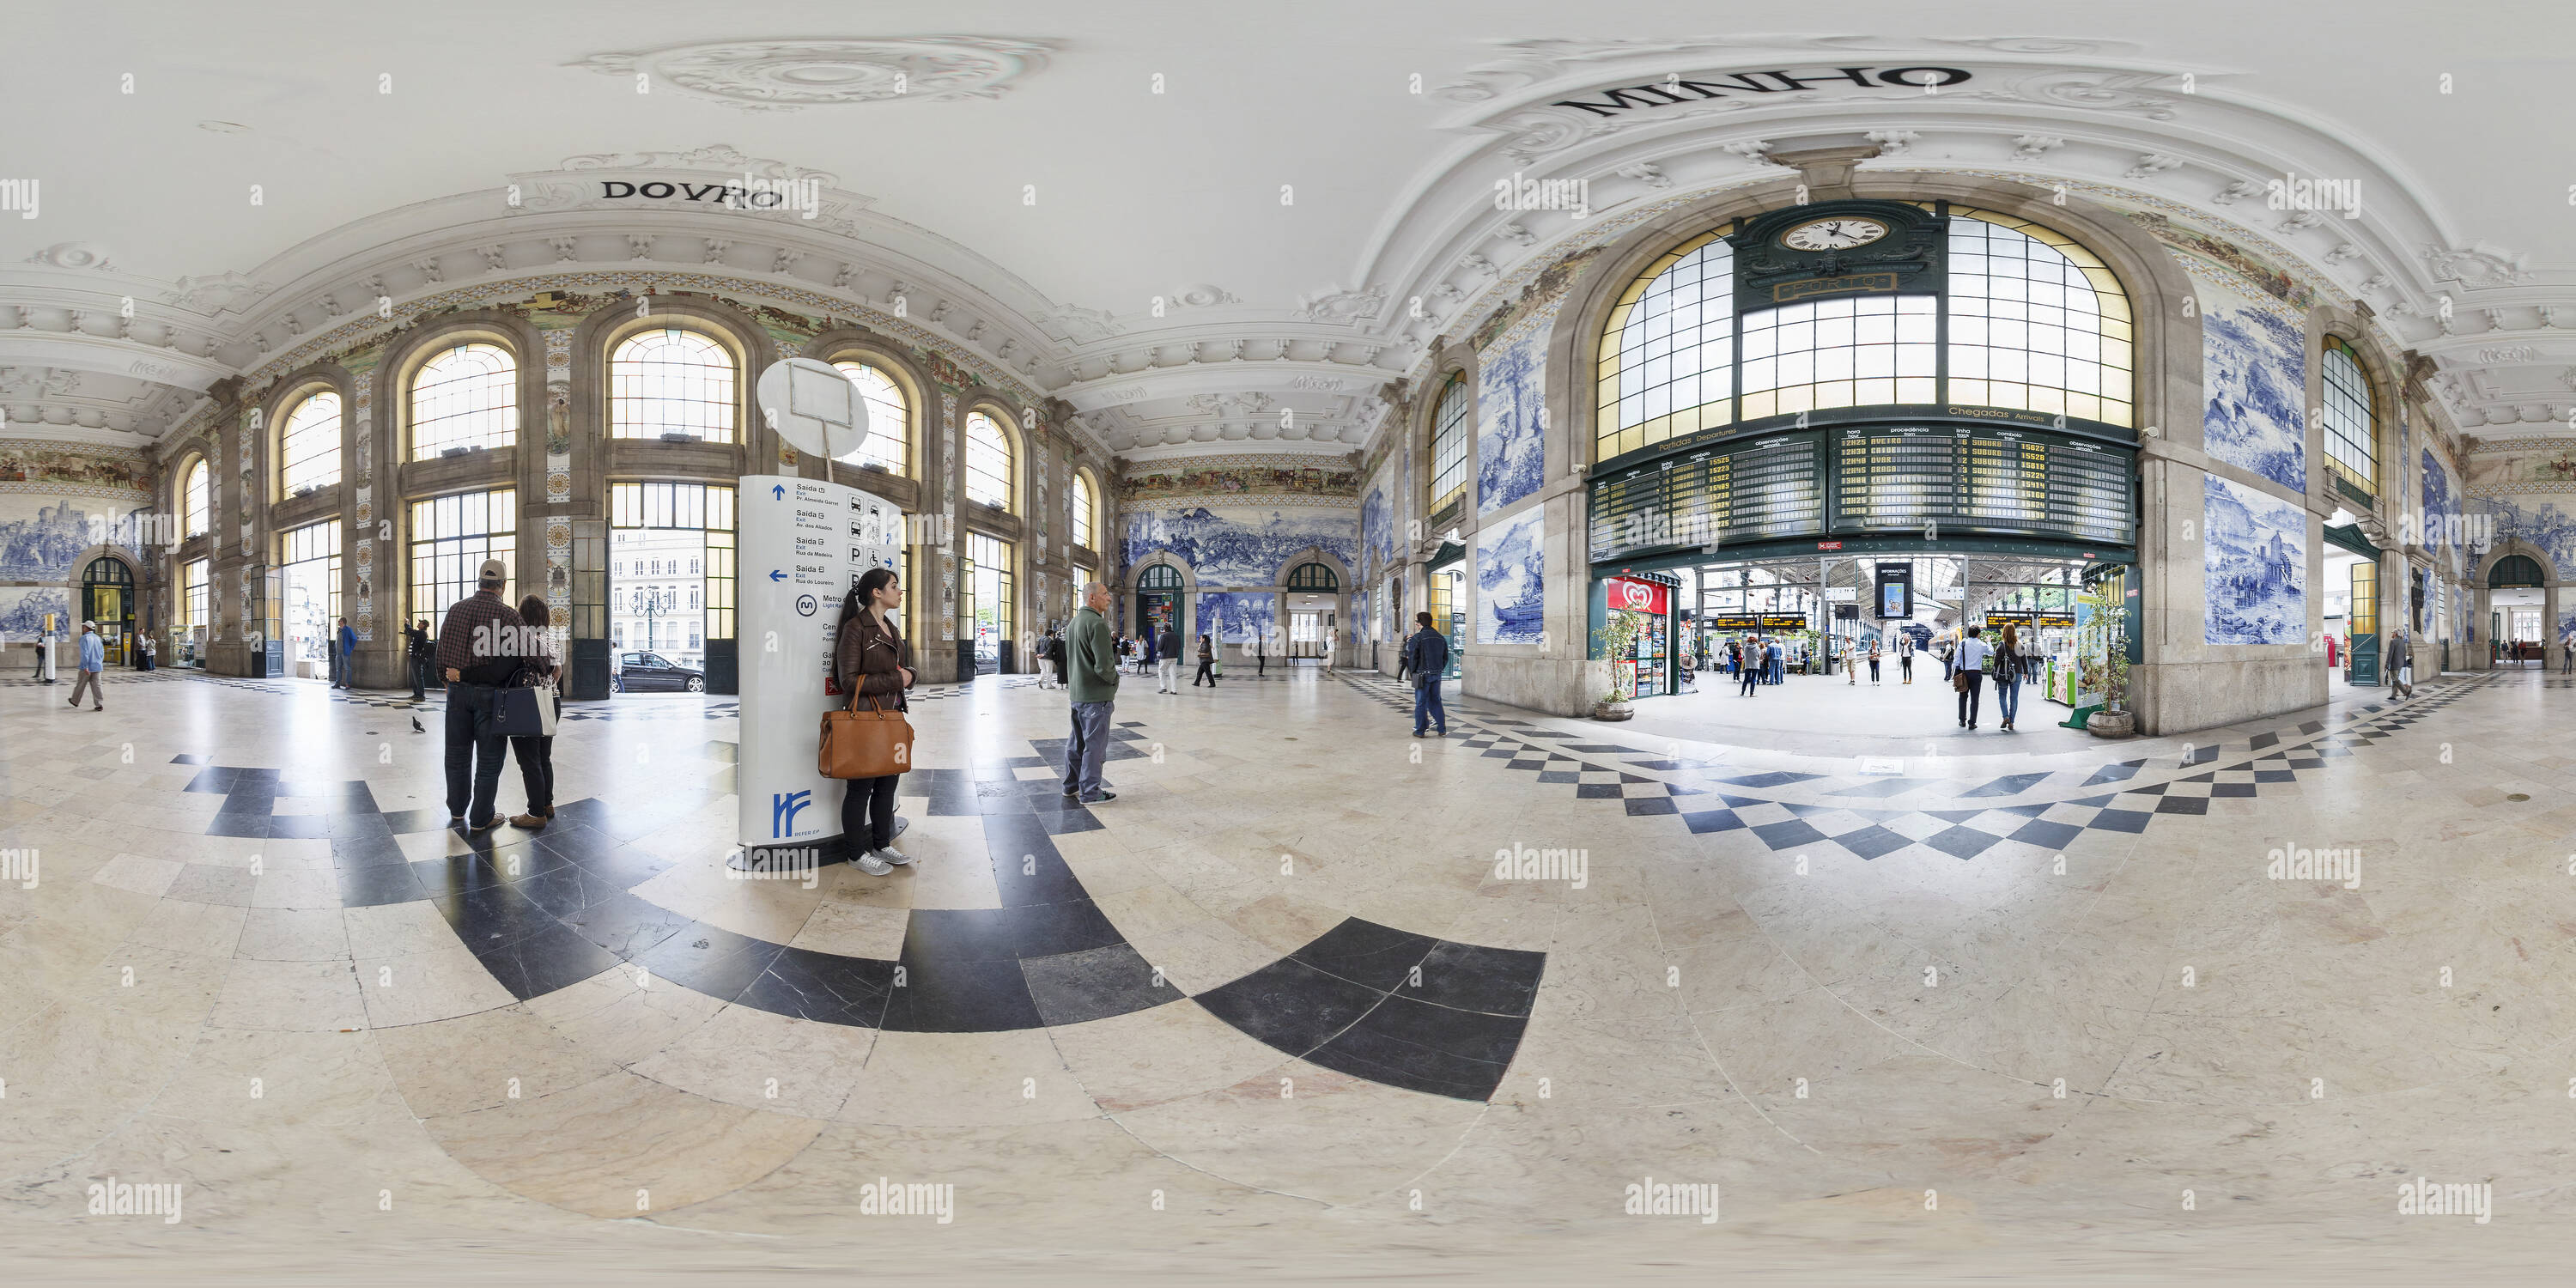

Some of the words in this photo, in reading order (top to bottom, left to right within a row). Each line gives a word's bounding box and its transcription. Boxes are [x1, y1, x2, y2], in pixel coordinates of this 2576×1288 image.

[1551, 67, 1973, 118] MINHO
[1793, 276, 1876, 293] PORTO
[1948, 407, 2009, 418] Chegadas
[2014, 412, 2044, 422] Arrivals
[1658, 436, 1692, 452] Partidas
[1696, 428, 1737, 441] Departures
[2020, 443, 2045, 453] 15622
[1709, 456, 1729, 465] 15525
[2020, 452, 2045, 461] 15528
[1709, 465, 1729, 475] 15223
[2020, 471, 2045, 479] 15224
[1709, 473, 1729, 483] 15922
[852, 548, 860, 562] P
